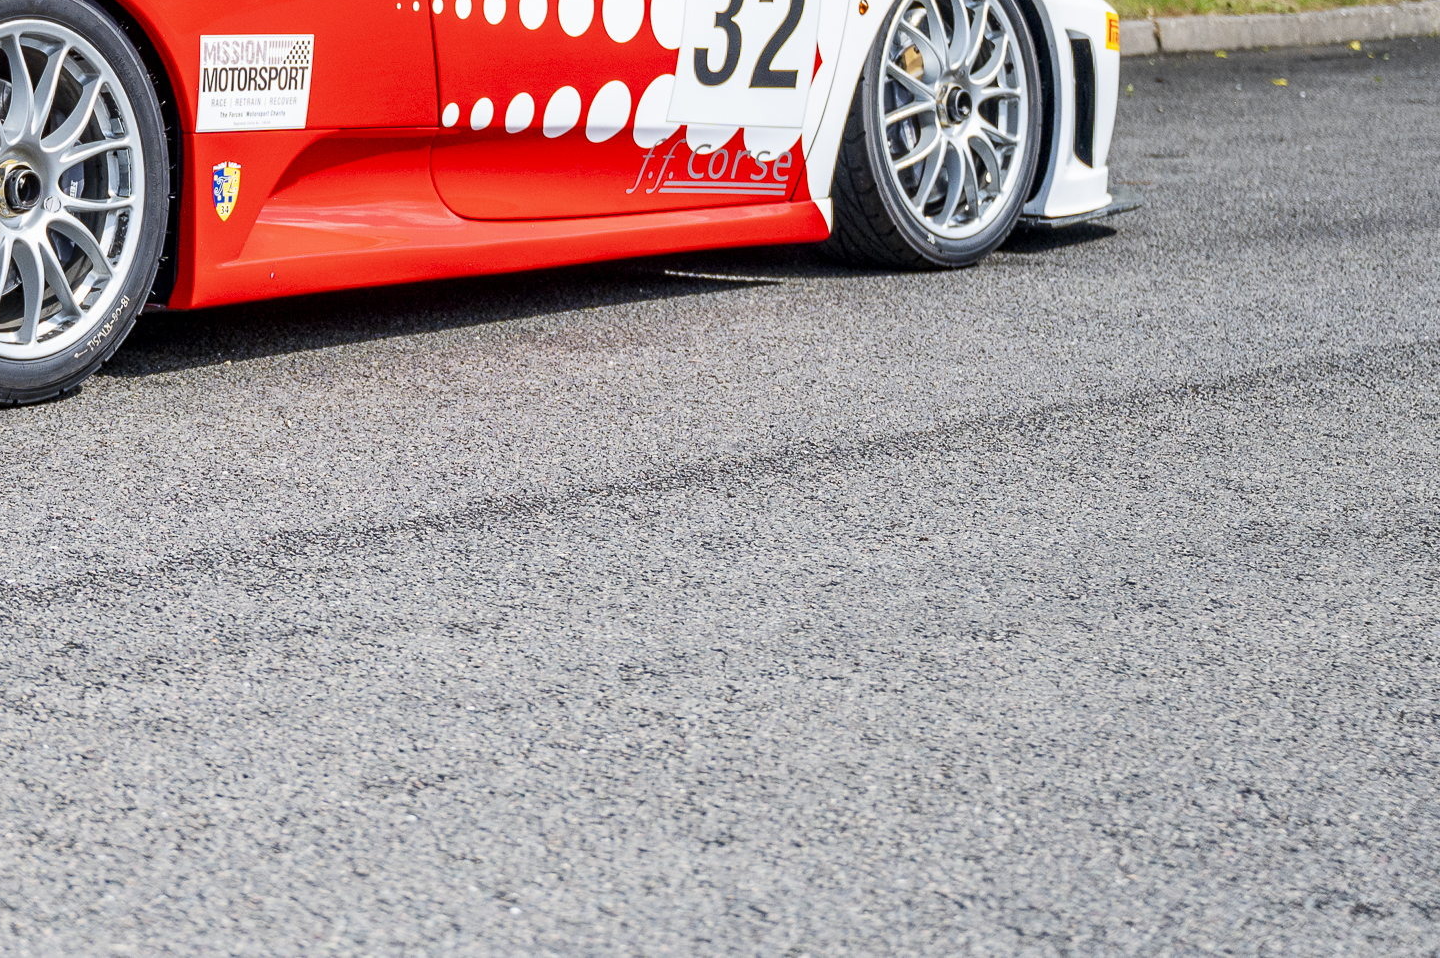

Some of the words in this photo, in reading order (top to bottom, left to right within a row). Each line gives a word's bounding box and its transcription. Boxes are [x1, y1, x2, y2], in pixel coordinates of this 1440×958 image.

[203, 40, 268, 65] MISSION
[202, 66, 309, 93] MOTORSPORT
[211, 98, 227, 107] RACE
[235, 97, 261, 106] RETRAIN
[269, 96, 297, 105] RECOVER
